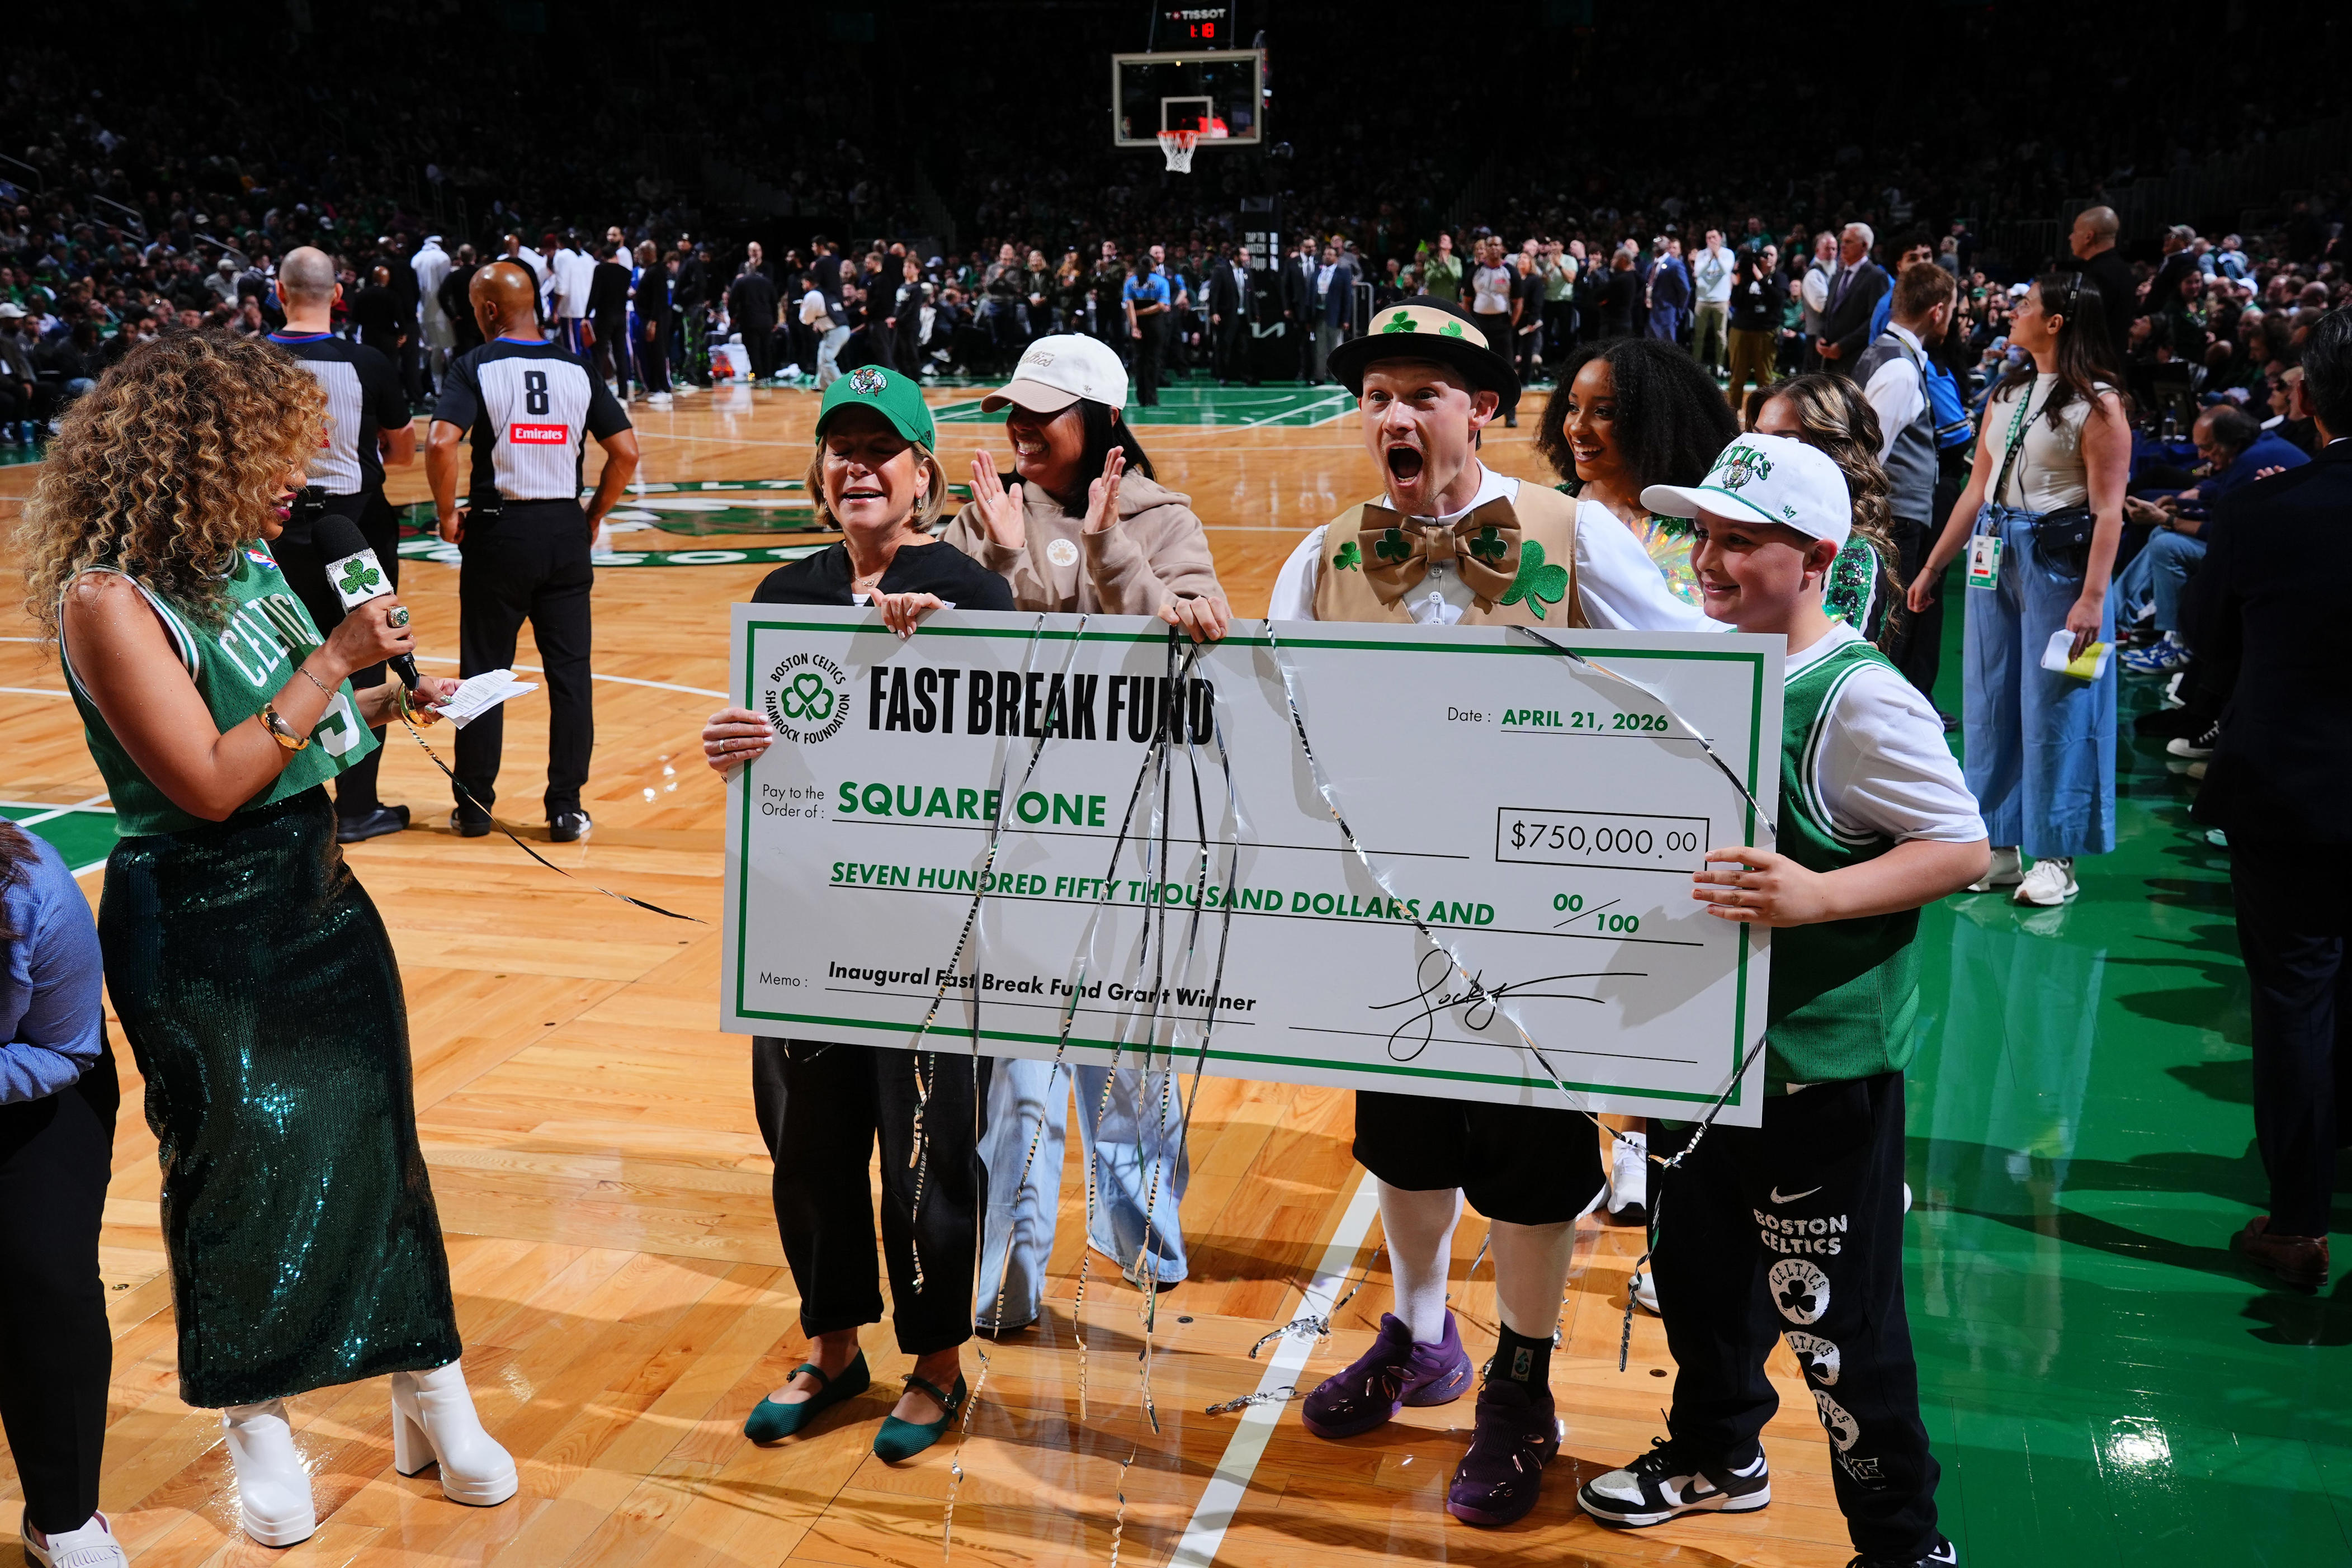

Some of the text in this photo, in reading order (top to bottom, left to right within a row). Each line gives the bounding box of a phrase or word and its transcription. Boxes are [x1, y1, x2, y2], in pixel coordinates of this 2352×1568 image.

[1180, 8, 1226, 20] TISSOT
[524, 371, 549, 415] 8
[515, 427, 563, 441] Emirates
[771, 653, 846, 684] BOSTON CELTICS
[766, 690, 849, 744] SHAMROCK FOUNDATION
[869, 667, 1214, 745] FAST BREAK FUND
[1501, 709, 1563, 727] APRIL
[1571, 712, 1604, 732] 21,
[1613, 714, 1668, 732] 2026
[762, 782, 1106, 827] Pay to the SQUARE ONE
[762, 803, 800, 818] Order
[1511, 820, 1697, 858] $750,000.00
[830, 862, 1639, 933] SEVEN HUNDRED FIFTY THOUSAND DOLLARS AND 00 100
[760, 971, 800, 986] Memo
[829, 961, 930, 988] Inaugural
[936, 967, 975, 989] Fast
[983, 973, 1044, 996] Break
[1050, 979, 1101, 999] Fund
[1108, 984, 1170, 1004] Grant
[1176, 988, 1257, 1012] Winner
[1753, 1208, 1848, 1236] BOSTON
[1760, 1229, 1841, 1255] CELTICS
[1772, 1262, 1826, 1291] CELTICS
[1791, 1335, 1834, 1357] LTICS
[1820, 1394, 1849, 1423] TICS
